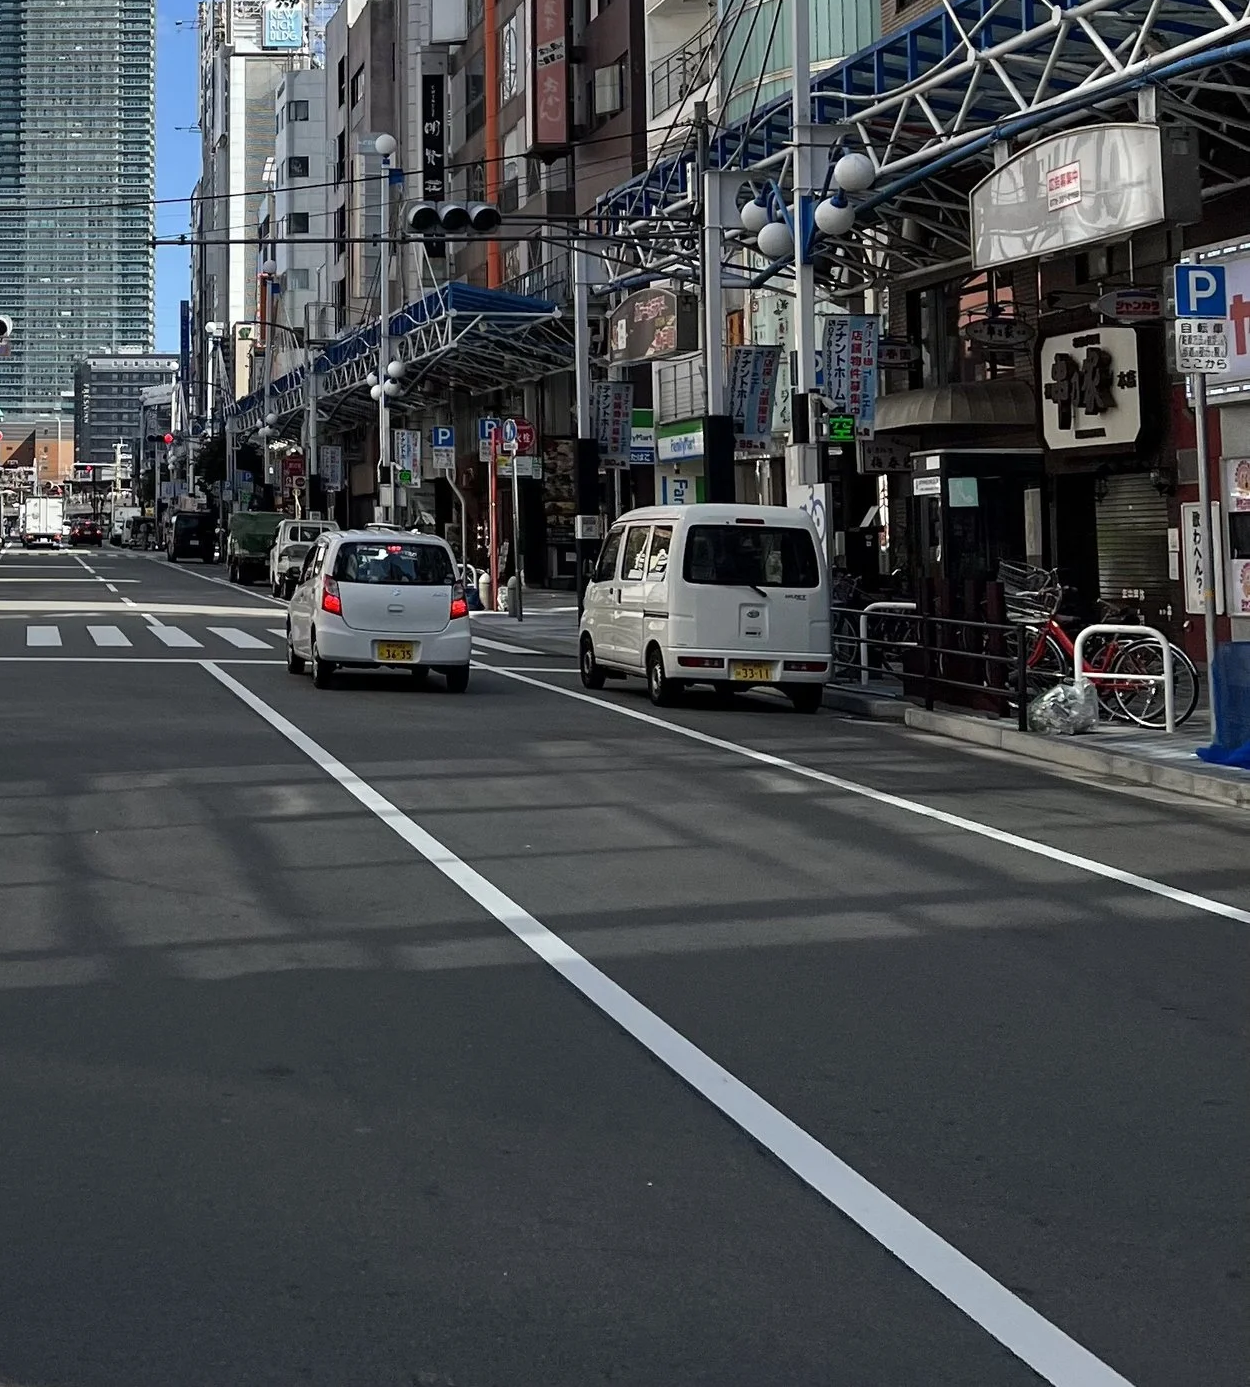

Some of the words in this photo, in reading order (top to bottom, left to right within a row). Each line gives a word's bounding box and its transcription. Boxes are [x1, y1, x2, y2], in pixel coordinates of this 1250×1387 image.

[269, 10, 296, 21] NEW
[269, 21, 295, 32] RICH
[1188, 269, 1218, 312] P
[1181, 323, 1223, 334] 自転車
[834, 319, 849, 401] テナントホーム
[1180, 358, 1227, 370] ここから
[437, 427, 450, 445] P
